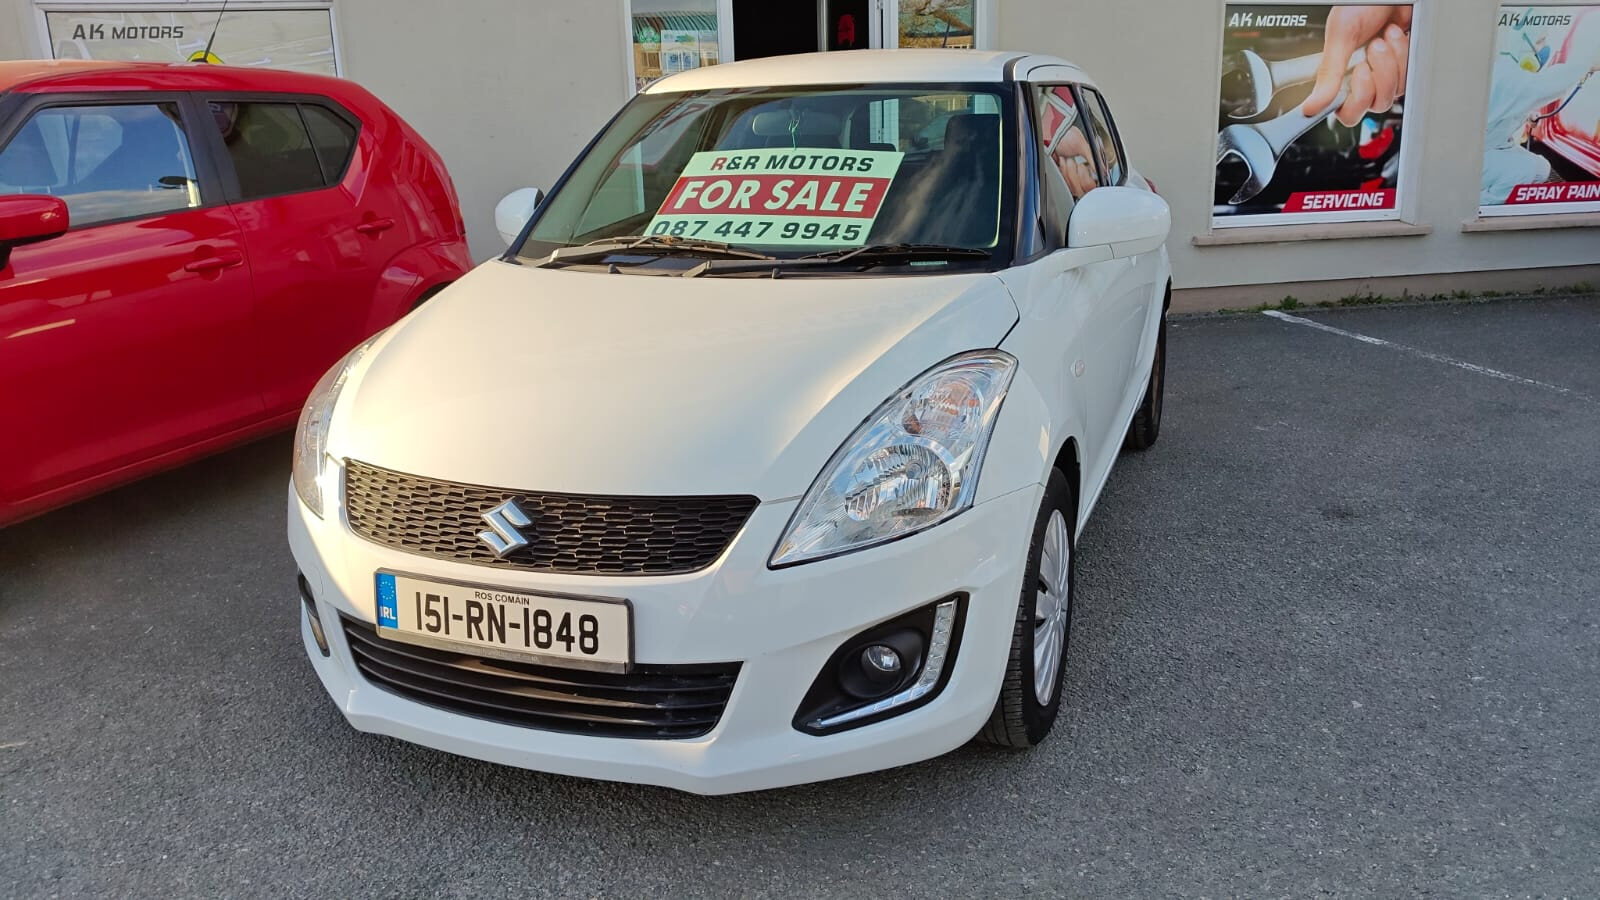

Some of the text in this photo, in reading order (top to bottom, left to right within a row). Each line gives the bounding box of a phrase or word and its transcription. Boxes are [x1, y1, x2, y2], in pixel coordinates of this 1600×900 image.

[1228, 12, 1308, 28] AK MOTORS
[1498, 13, 1571, 26] AK MOTORS
[72, 23, 184, 40] AK MOTORS
[710, 154, 874, 172] R&R MOTORS
[673, 180, 874, 213] FOR SALE
[1301, 192, 1385, 210] SERVICING
[1515, 185, 1566, 201] SPRAY
[651, 220, 862, 241] 087 447 9945
[474, 591, 493, 601] ROS
[379, 606, 397, 620] IRL
[415, 591, 600, 655] 151-RN-1848
